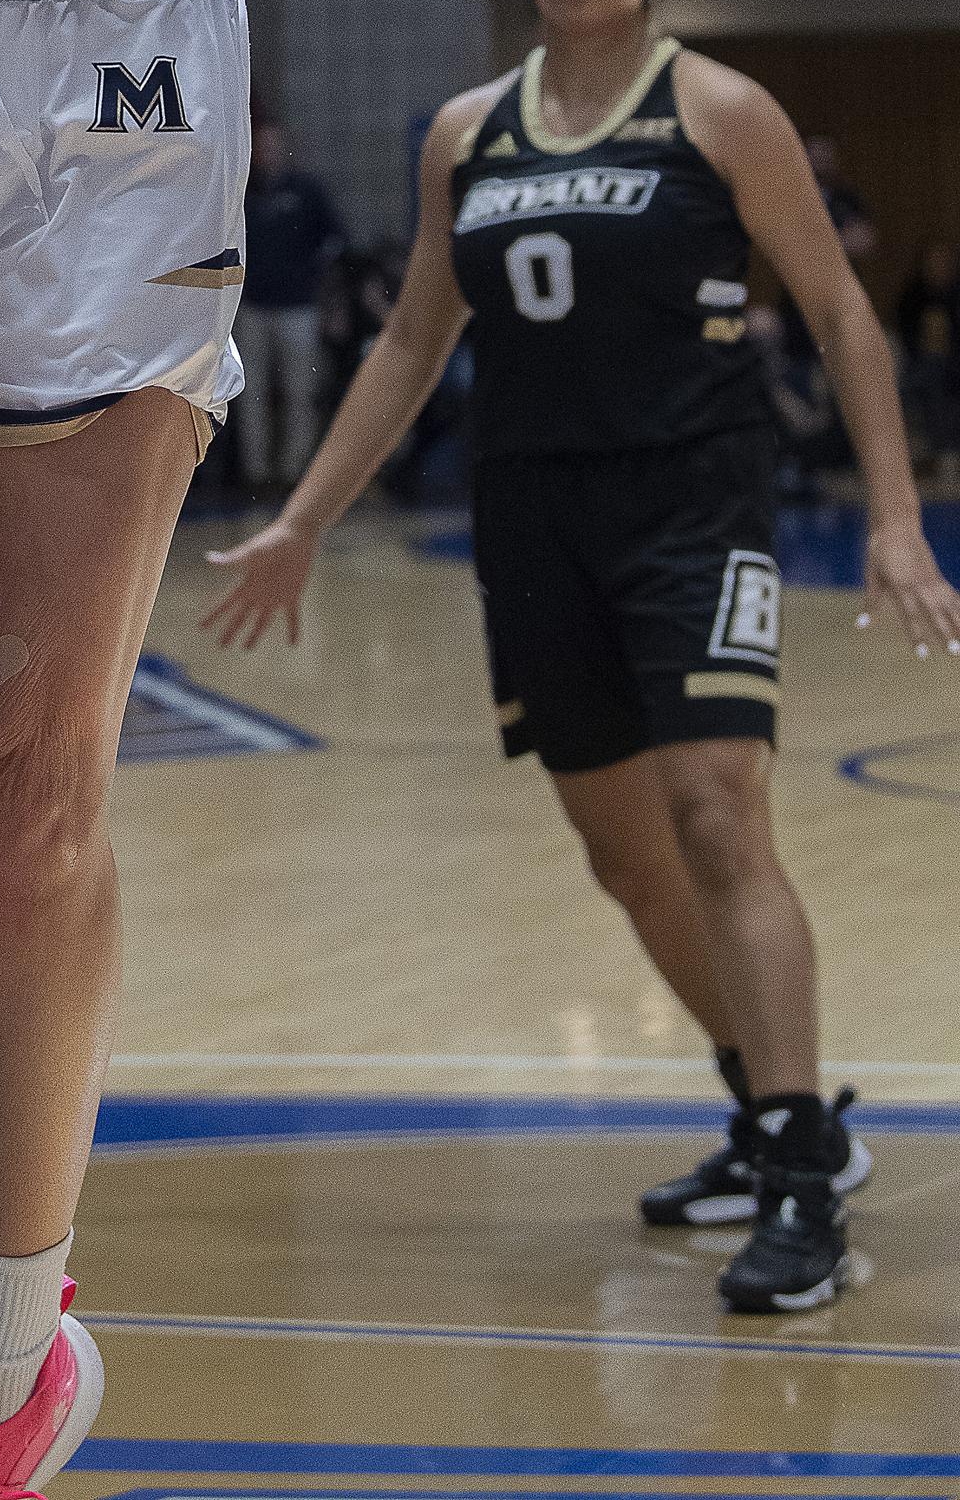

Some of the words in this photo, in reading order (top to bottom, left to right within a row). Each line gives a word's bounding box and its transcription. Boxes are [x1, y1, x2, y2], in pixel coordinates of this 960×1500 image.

[86, 56, 195, 133] M
[459, 169, 648, 224] BRYANT
[504, 231, 575, 323] 0
